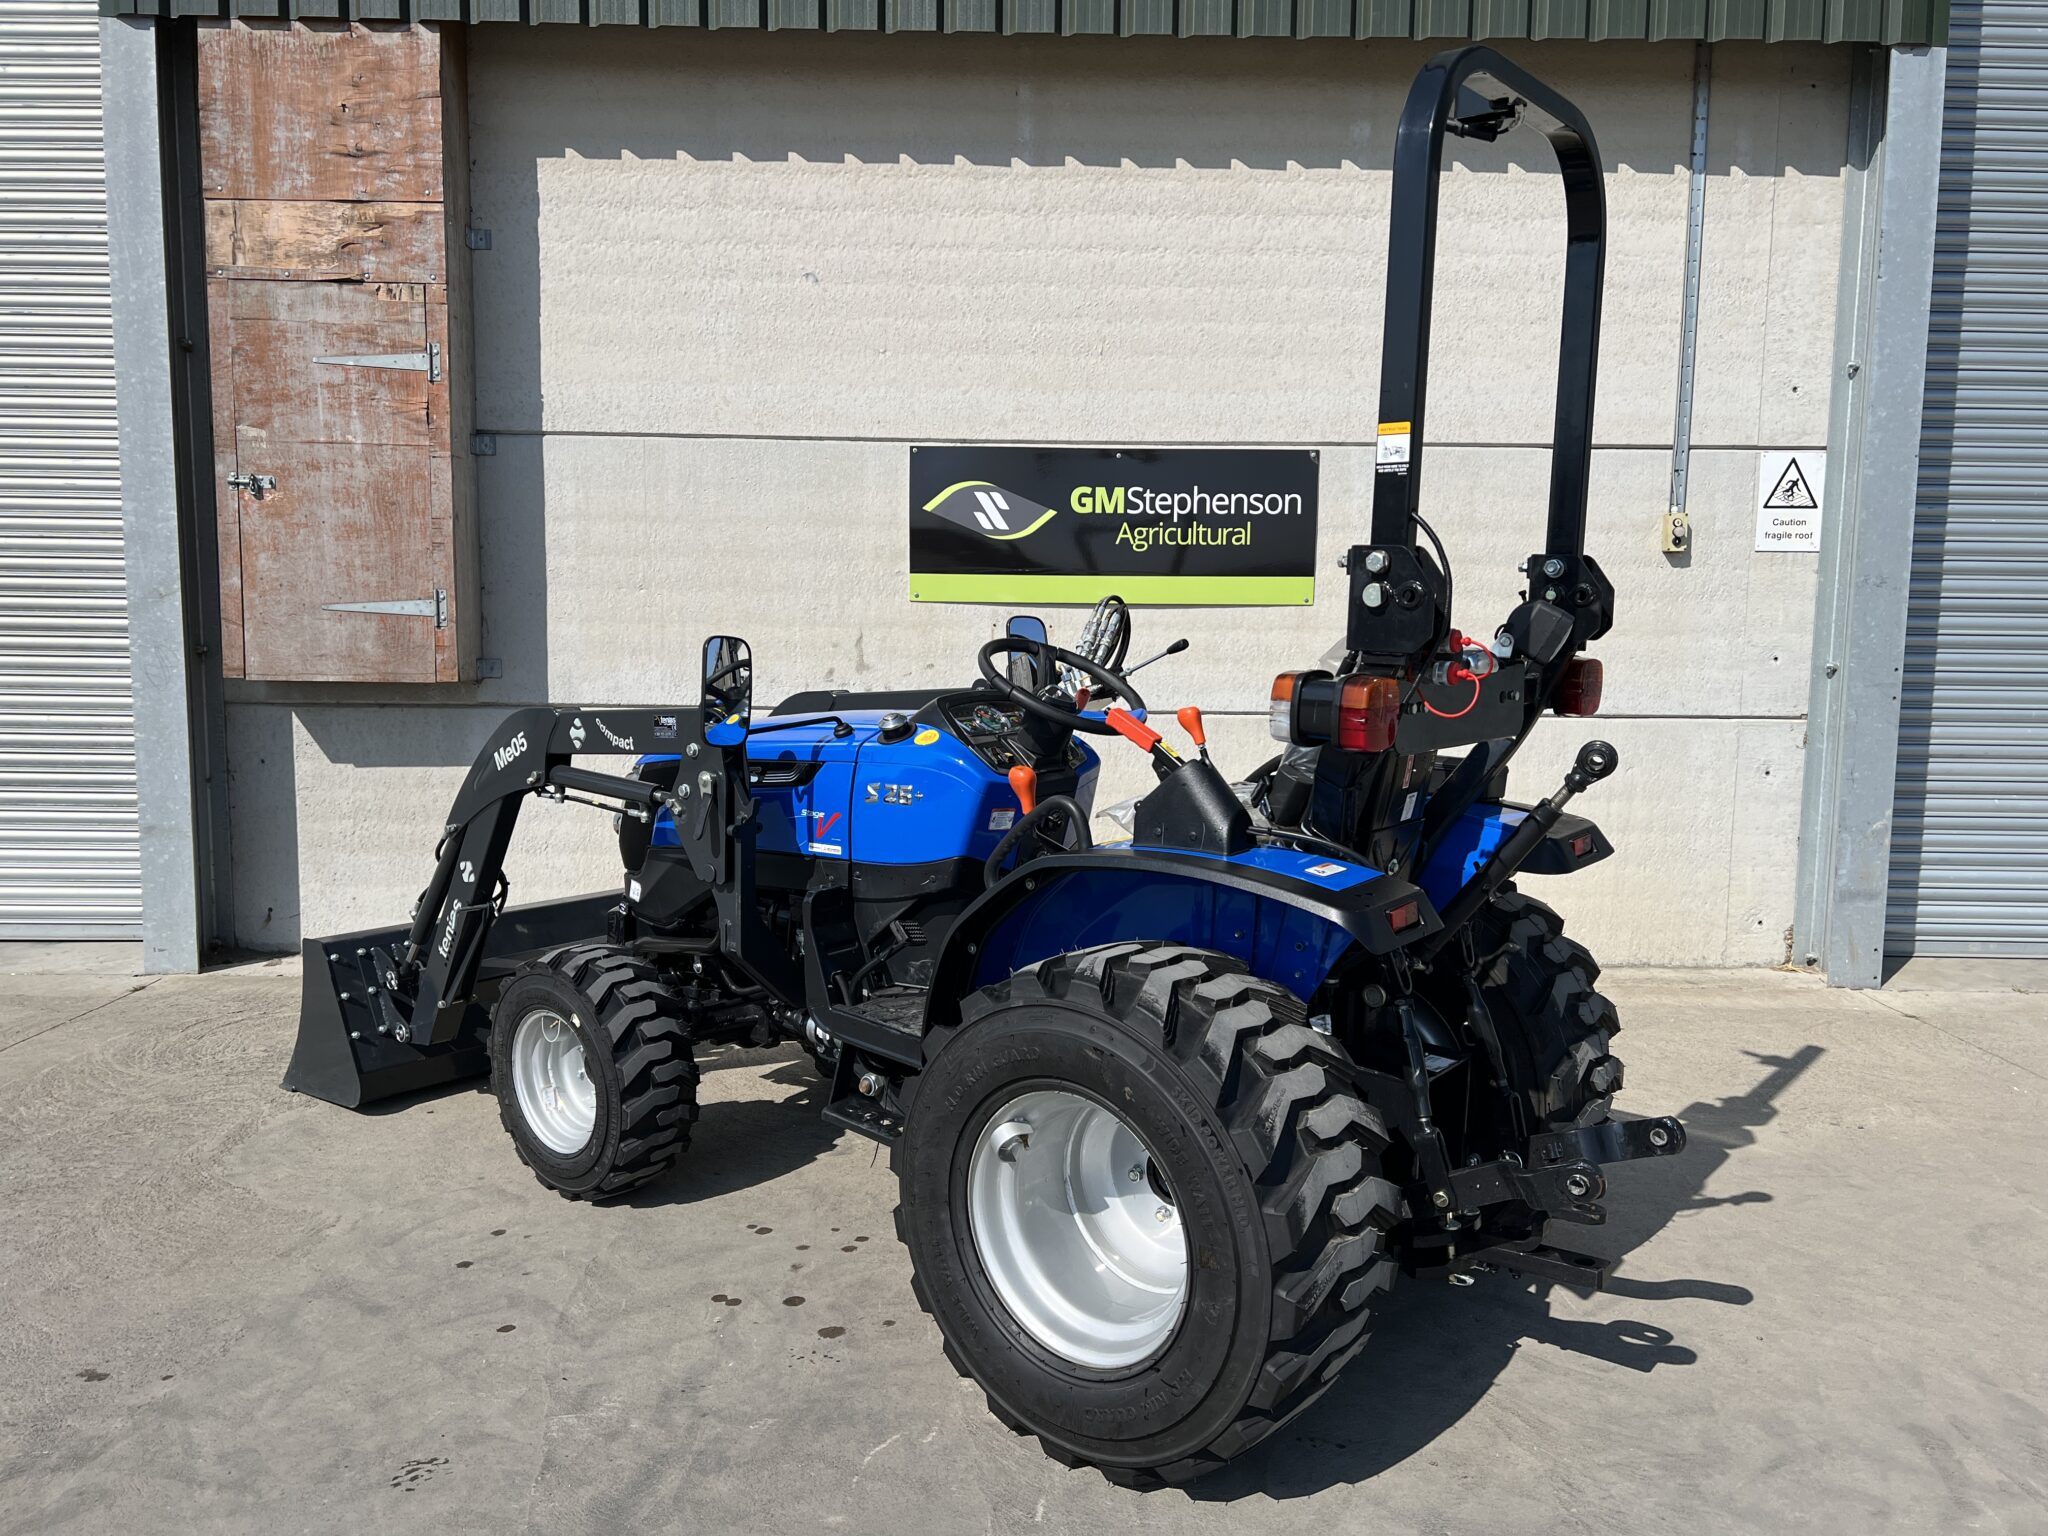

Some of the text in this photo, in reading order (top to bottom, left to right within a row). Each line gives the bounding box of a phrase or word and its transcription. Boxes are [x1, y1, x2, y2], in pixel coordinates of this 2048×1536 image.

[1070, 486, 1302, 522] GMStephenson
[1115, 521, 1252, 552] Agricultural
[1764, 531, 1813, 541] fragile roof
[1772, 518, 1807, 526] Caution
[493, 731, 528, 771] Me05
[595, 717, 634, 751] compact
[801, 808, 842, 839] Stage V
[437, 898, 462, 959] tenias
[1199, 1128, 1240, 1192] POWER
